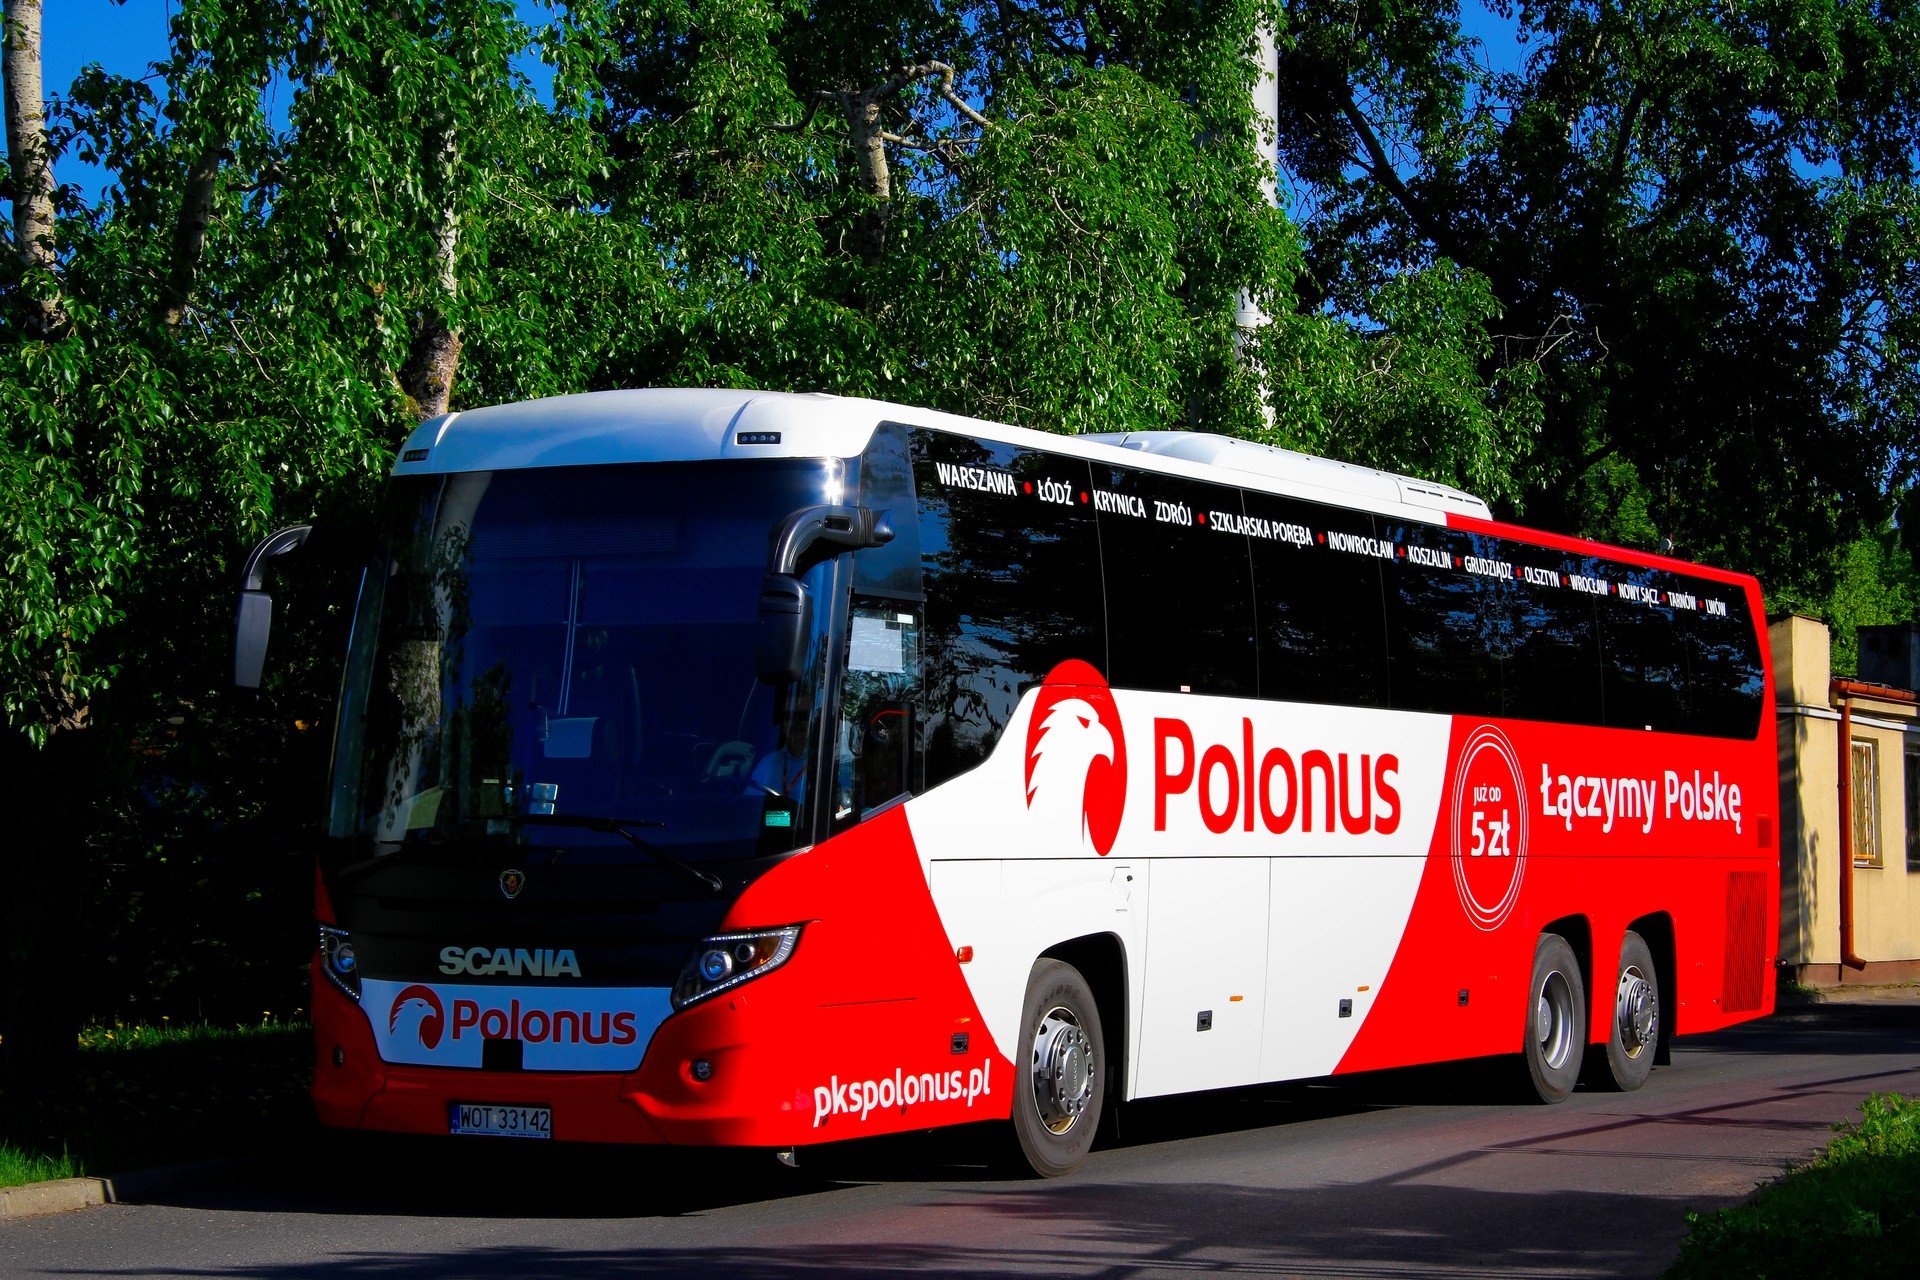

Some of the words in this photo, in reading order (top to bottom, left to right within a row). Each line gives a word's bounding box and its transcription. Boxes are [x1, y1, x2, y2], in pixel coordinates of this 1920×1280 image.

[936, 461, 1018, 497] WARSZAWA
[1037, 477, 1074, 506] ŁÓDŹ
[1093, 490, 1146, 518] KRYNICA
[1153, 500, 1193, 527] ZDRÓJ
[1209, 510, 1272, 540] SZKLARSKA
[1272, 519, 1314, 549] PORĘBA
[1328, 530, 1394, 560] INOWROCŁAW
[1407, 544, 1452, 570] KOSZALIN
[1464, 555, 1514, 583] GRUDZIĄDZ
[1524, 565, 1561, 588] OLSZTYN
[1570, 574, 1608, 596] WROCŁAW
[1618, 583, 1640, 601] NOWY
[1640, 586, 1660, 608] SĄCZ
[1666, 591, 1697, 611] TARNÓW
[1705, 598, 1727, 617] LWÓW
[1154, 717, 1402, 836] Polonus
[1473, 782, 1488, 807] JUŻ
[1488, 786, 1502, 803] OD
[1540, 763, 1657, 835] Łączymy
[1664, 770, 1742, 835] Polskę
[1471, 811, 1486, 857] 5
[1487, 809, 1511, 857] zł
[438, 946, 582, 977] SCANIA
[452, 998, 637, 1045] Polonus
[813, 1058, 991, 1128] pkspolonus.pl
[460, 1106, 492, 1129] WOT
[498, 1109, 549, 1132] 33142
